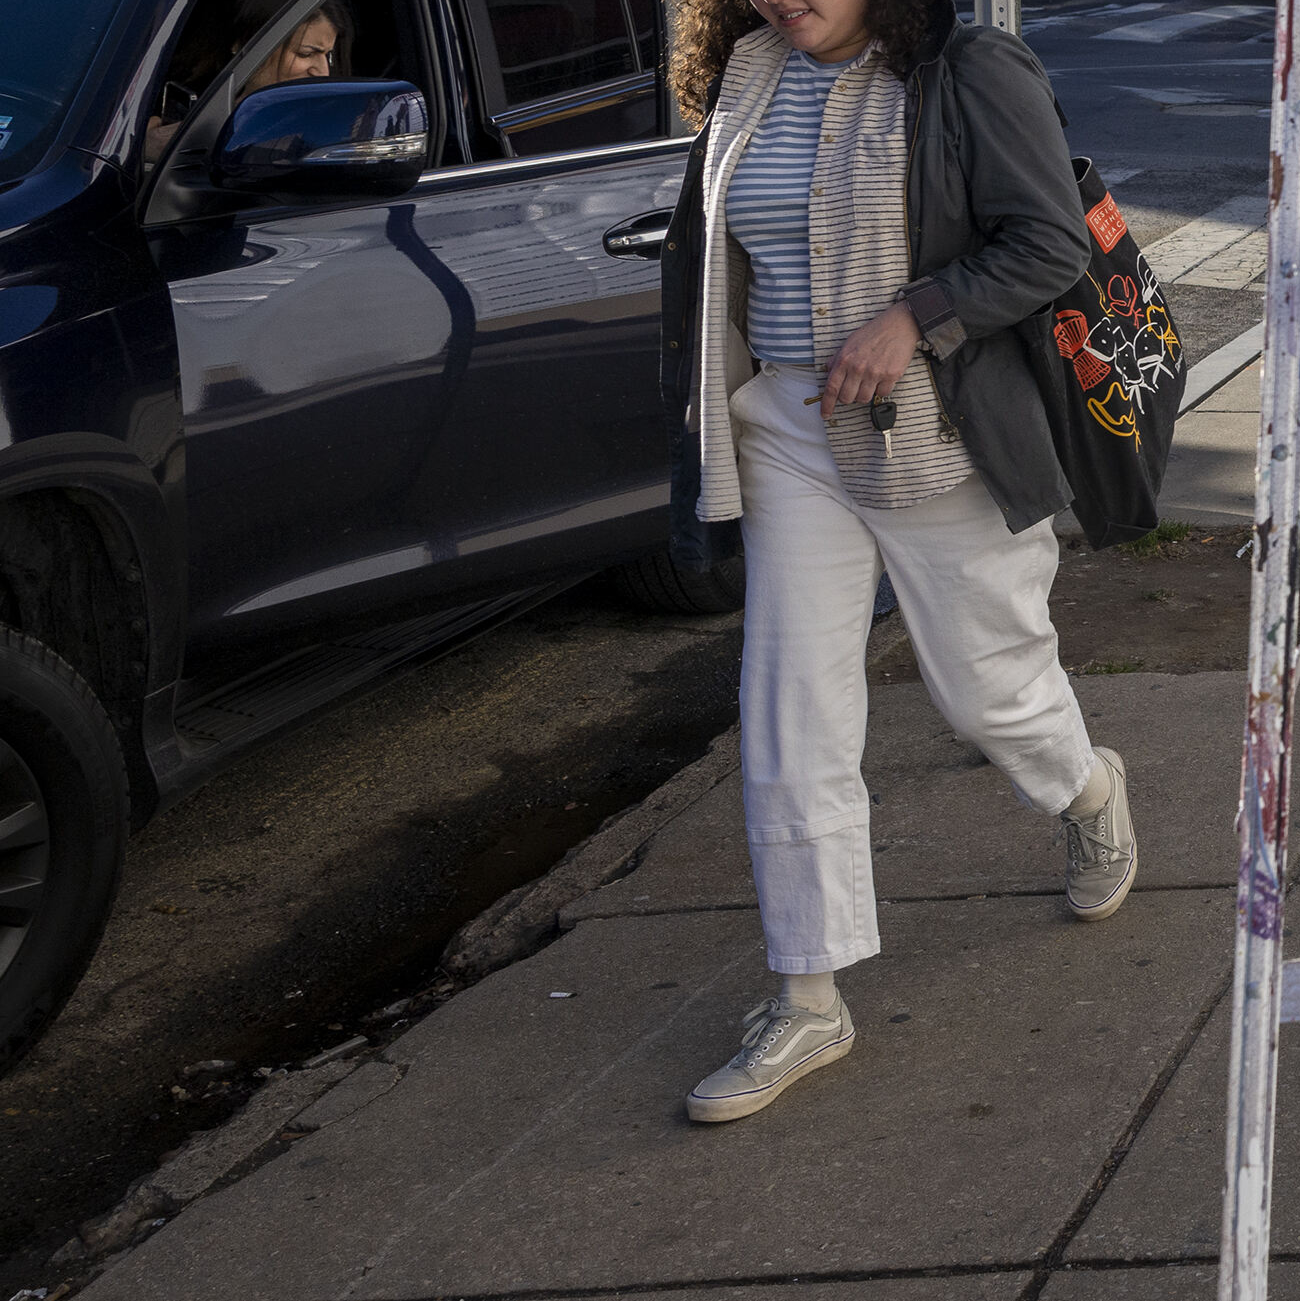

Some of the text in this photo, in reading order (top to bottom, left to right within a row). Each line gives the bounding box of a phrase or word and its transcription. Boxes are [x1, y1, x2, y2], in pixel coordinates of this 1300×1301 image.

[1093, 201, 1115, 225] DESIG
[1100, 209, 1121, 233] WITHI
[1105, 220, 1122, 241] REAC
